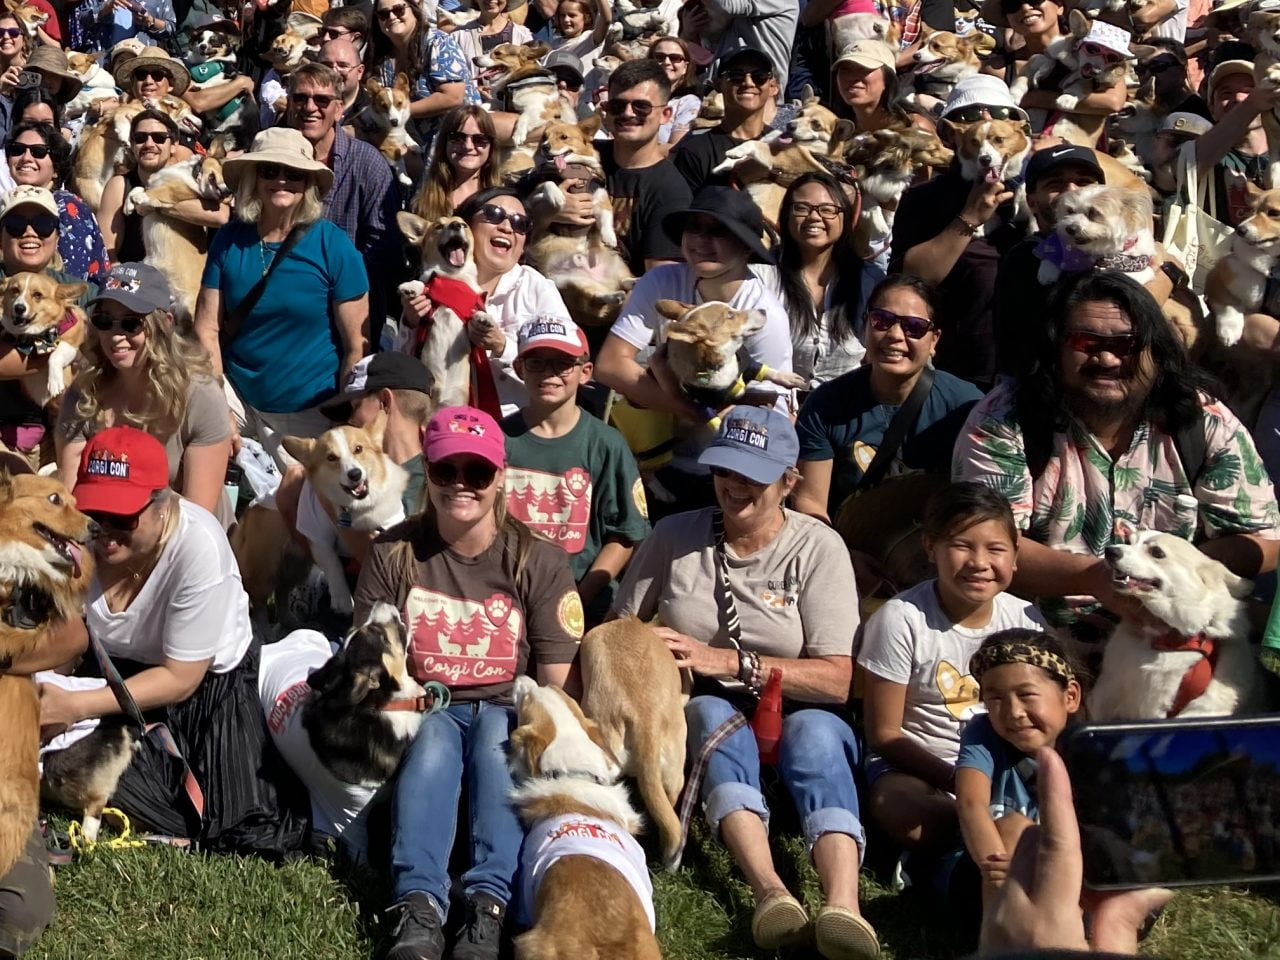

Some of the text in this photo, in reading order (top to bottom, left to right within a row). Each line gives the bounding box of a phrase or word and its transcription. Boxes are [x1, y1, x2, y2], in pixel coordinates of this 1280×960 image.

[549, 324, 564, 334] CON
[749, 431, 766, 449] CON
[110, 461, 127, 477] CON
[558, 526, 582, 541] Con
[423, 656, 507, 681] Corgi Con
[285, 682, 312, 705] ORGI
